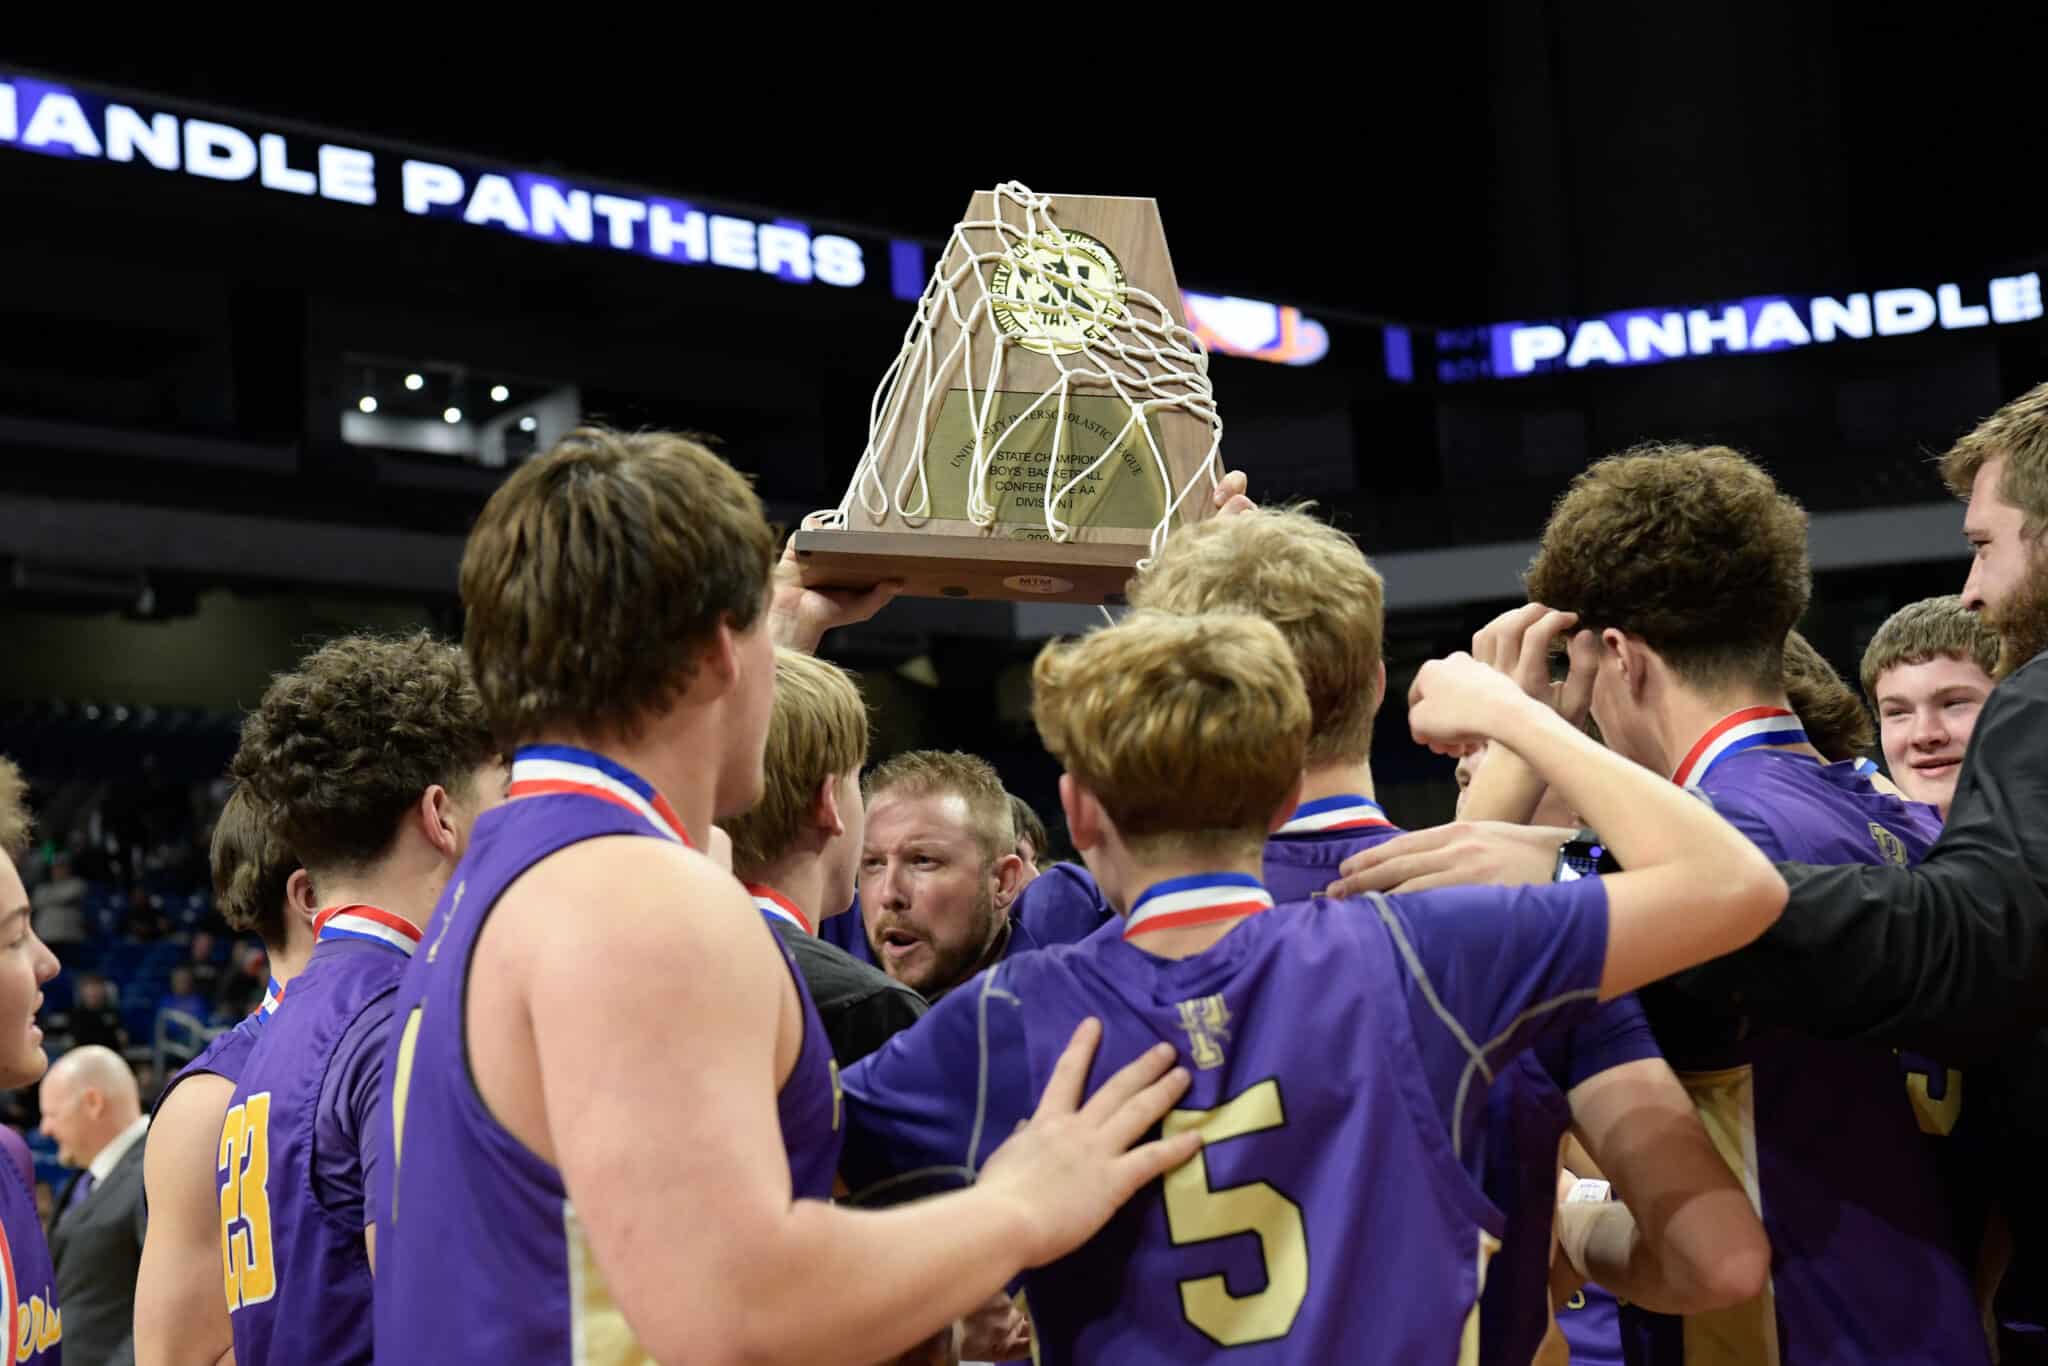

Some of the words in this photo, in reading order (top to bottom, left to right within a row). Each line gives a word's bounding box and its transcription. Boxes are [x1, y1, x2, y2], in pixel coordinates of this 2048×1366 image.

[402, 160, 865, 287] PANTHERS
[1510, 272, 2044, 373] PANHANDLE
[996, 450, 1031, 463] STATE
[1080, 485, 1096, 496] AA
[1161, 1075, 1309, 1348] 5
